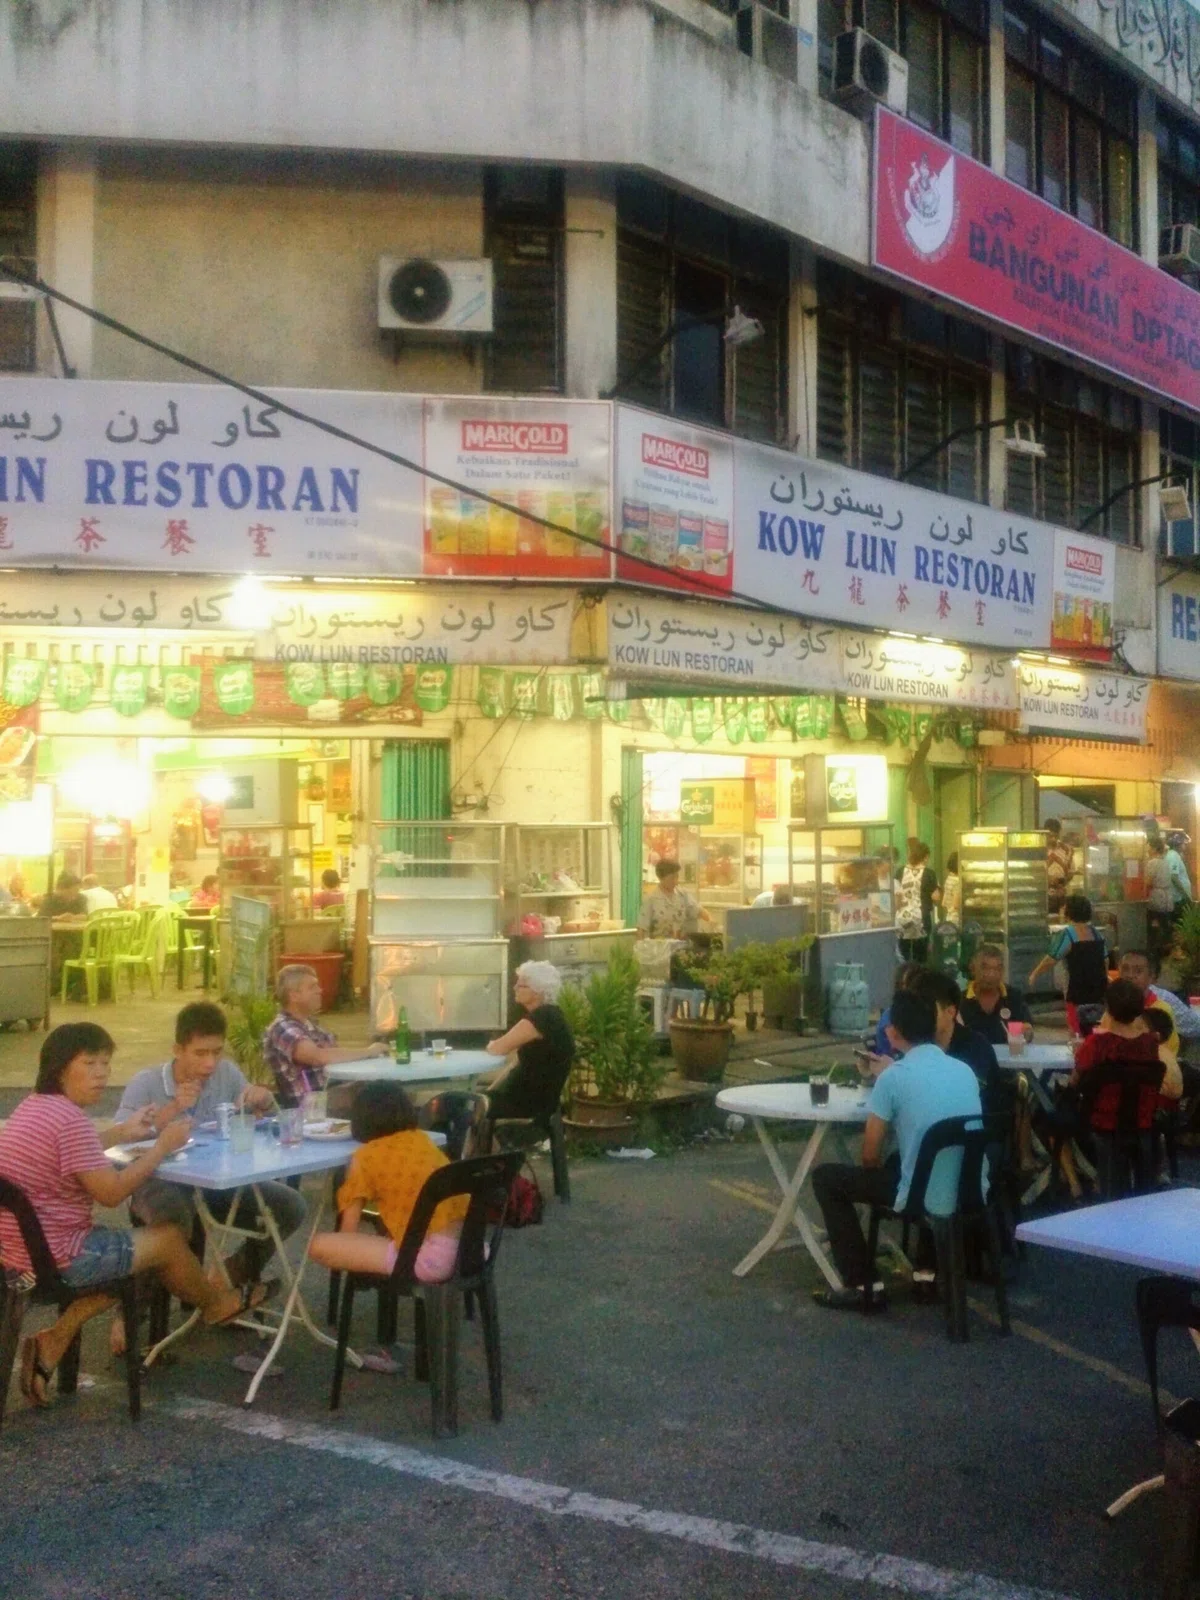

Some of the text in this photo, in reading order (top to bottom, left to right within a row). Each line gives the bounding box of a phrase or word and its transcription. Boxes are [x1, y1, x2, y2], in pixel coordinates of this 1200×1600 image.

[969, 220, 1120, 330] BANGUNAN
[105, 400, 180, 445] لون
[211, 403, 282, 447] كاو
[465, 424, 564, 449] MARIGOLD
[644, 437, 707, 469] MARIGOLD
[84, 458, 360, 513] RESTORAN
[769, 471, 1029, 556] كاو لون ريستوران
[757, 510, 1036, 605] KOW LUN RESTORAN
[99, 590, 158, 628] لون
[440, 601, 495, 642] لون
[506, 600, 569, 642] كاو
[611, 602, 834, 660] كاو لون ريستوران
[275, 643, 315, 662] KOW
[320, 644, 356, 663] LUN
[359, 645, 448, 664] RESTORAN
[615, 645, 754, 675] KOW LUN RESTORAN
[847, 672, 949, 698] KOW LUN RESTORAN
[1095, 678, 1119, 705] لون
[1023, 698, 1099, 719] KOW LUN RESTORAN
